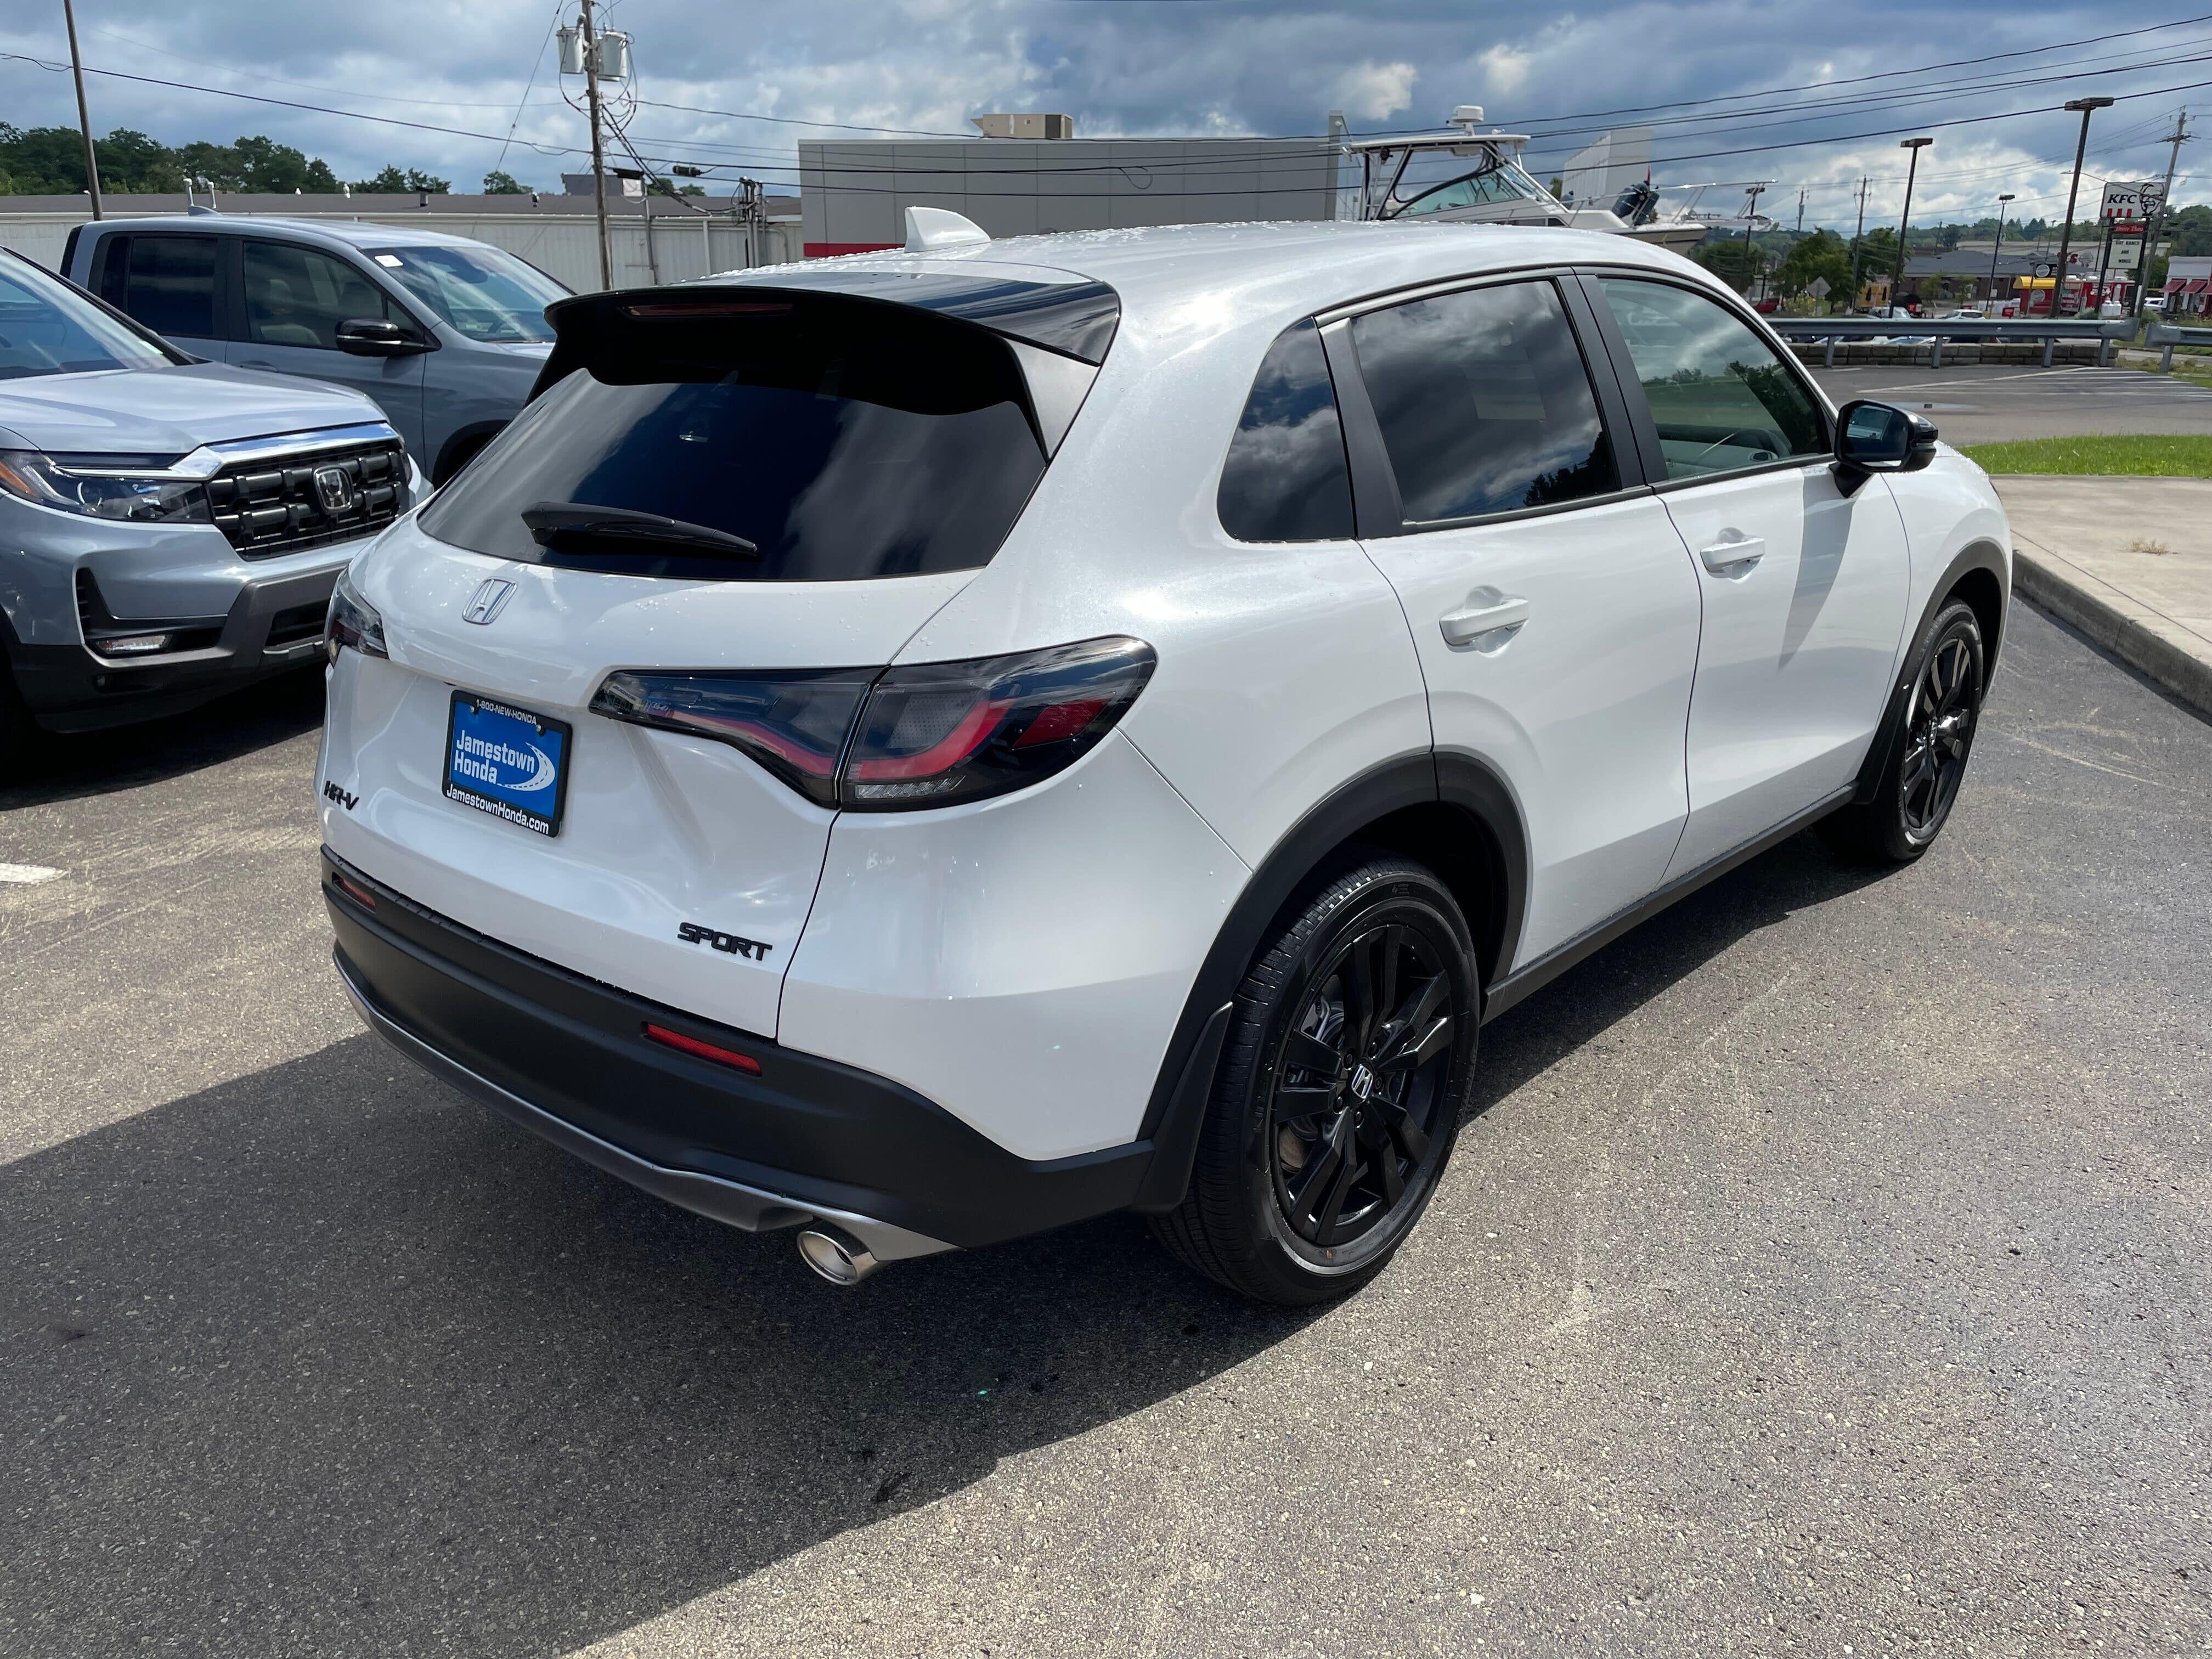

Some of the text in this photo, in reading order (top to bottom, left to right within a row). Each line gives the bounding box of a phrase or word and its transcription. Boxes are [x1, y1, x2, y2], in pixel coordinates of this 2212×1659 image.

[2107, 194, 2137, 204] KFC
[476, 698, 537, 726] 1-800-NEW-HONDA
[454, 750, 498, 785] Honda
[456, 730, 535, 774] Jamestown
[324, 780, 360, 811] HR-V
[446, 783, 549, 835] JamestownHonda.com
[676, 922, 773, 961] SPORT
